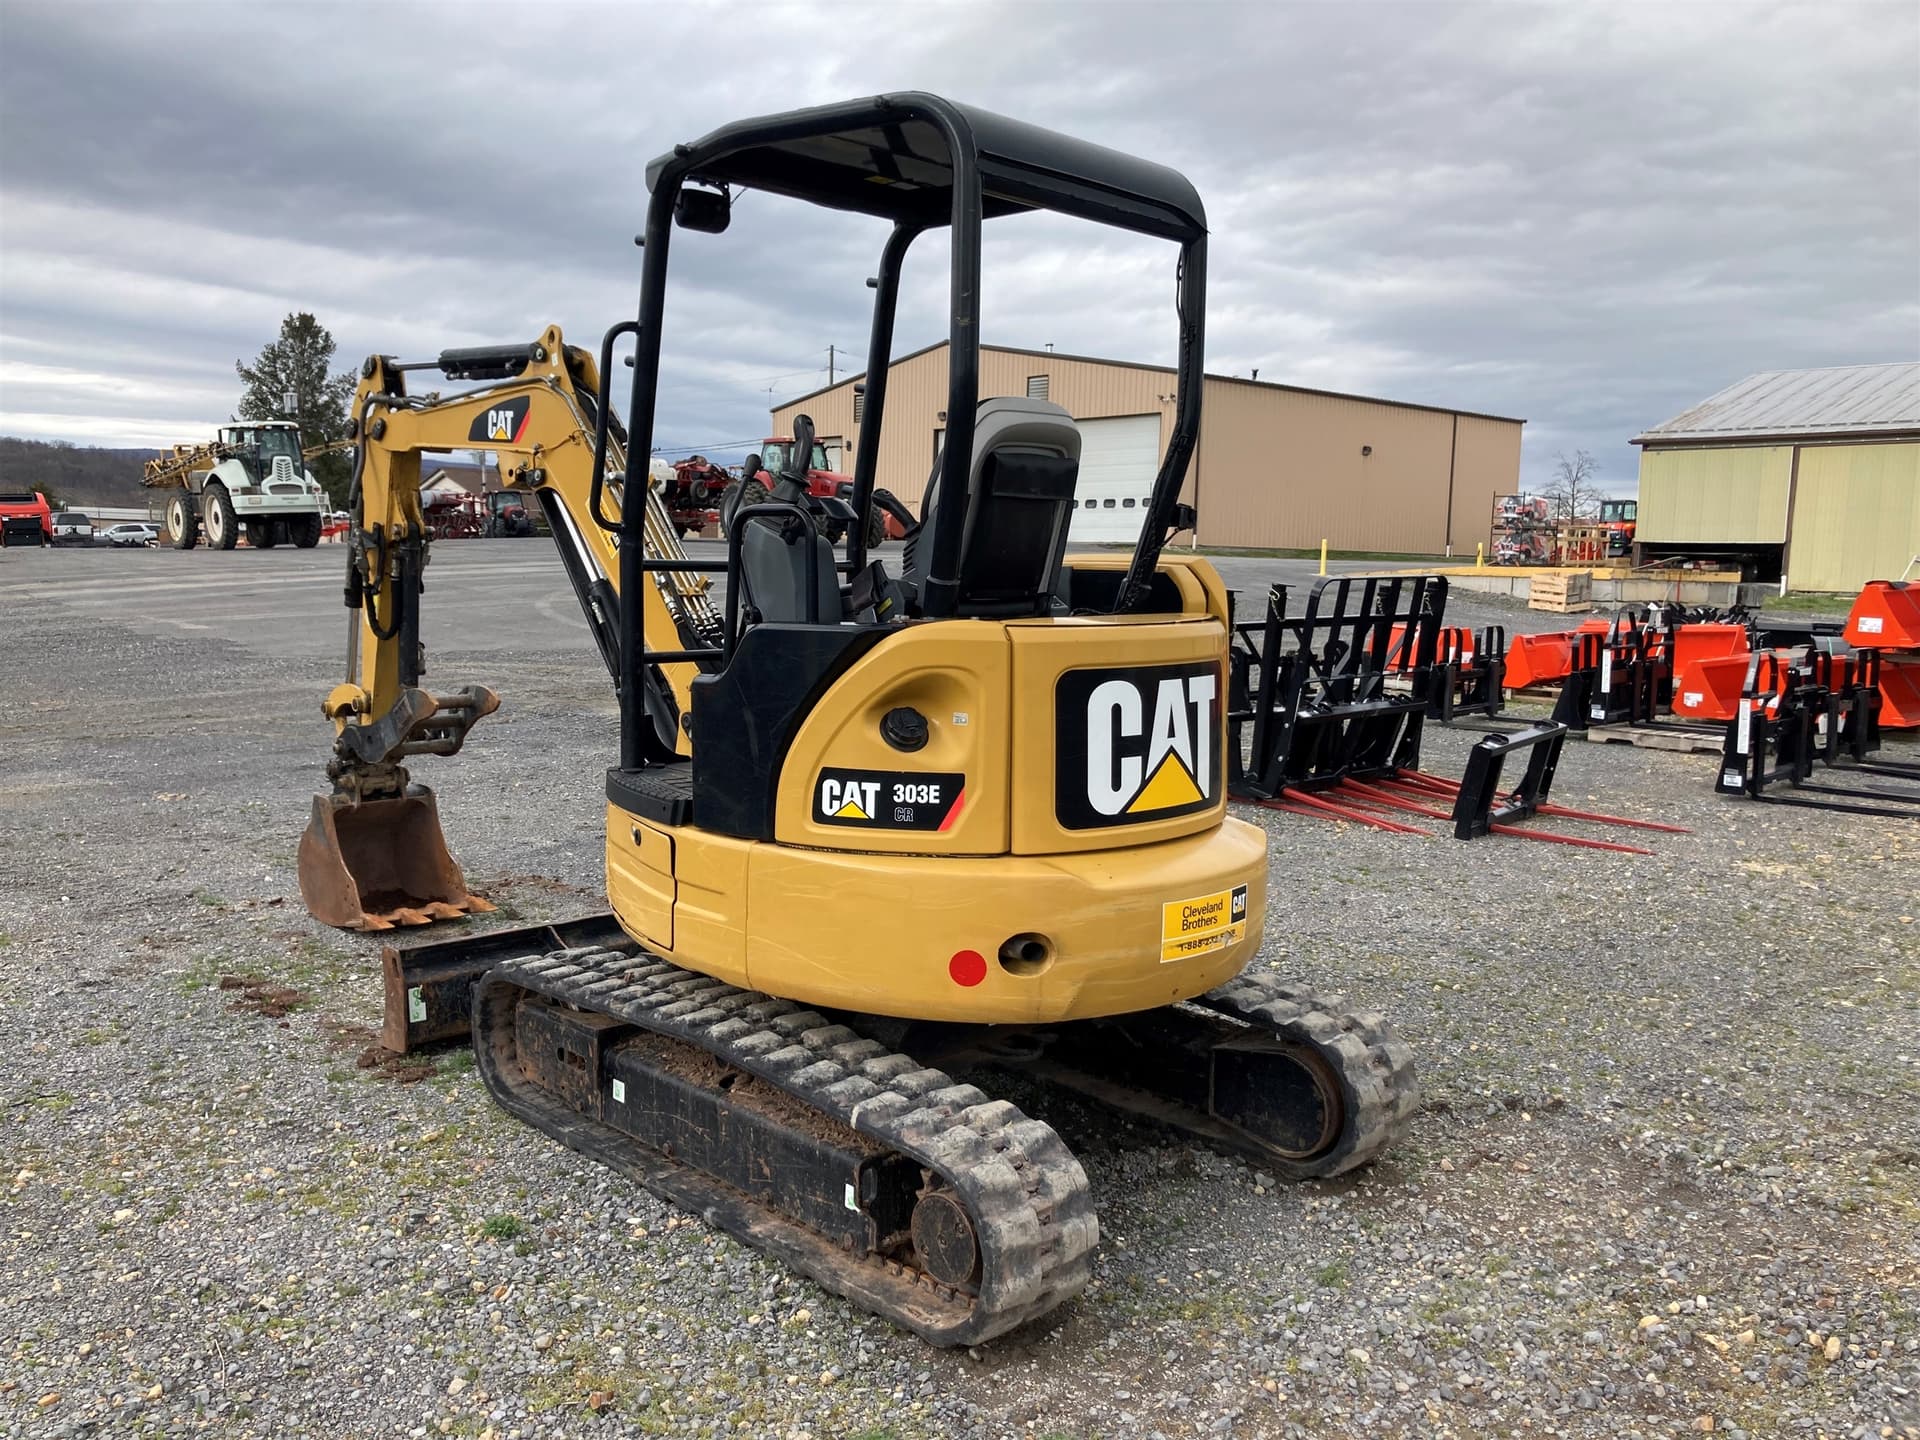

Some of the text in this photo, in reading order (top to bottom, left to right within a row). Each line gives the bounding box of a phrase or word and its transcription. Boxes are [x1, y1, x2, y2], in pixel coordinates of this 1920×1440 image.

[488, 409, 514, 440] CAT
[1087, 674, 1216, 816] CAT
[821, 778, 941, 820] CAT 303E
[894, 806, 914, 822] CR
[1182, 899, 1224, 919] Cleveland
[1232, 893, 1246, 914] CAT
[1182, 914, 1218, 931] Brothers
